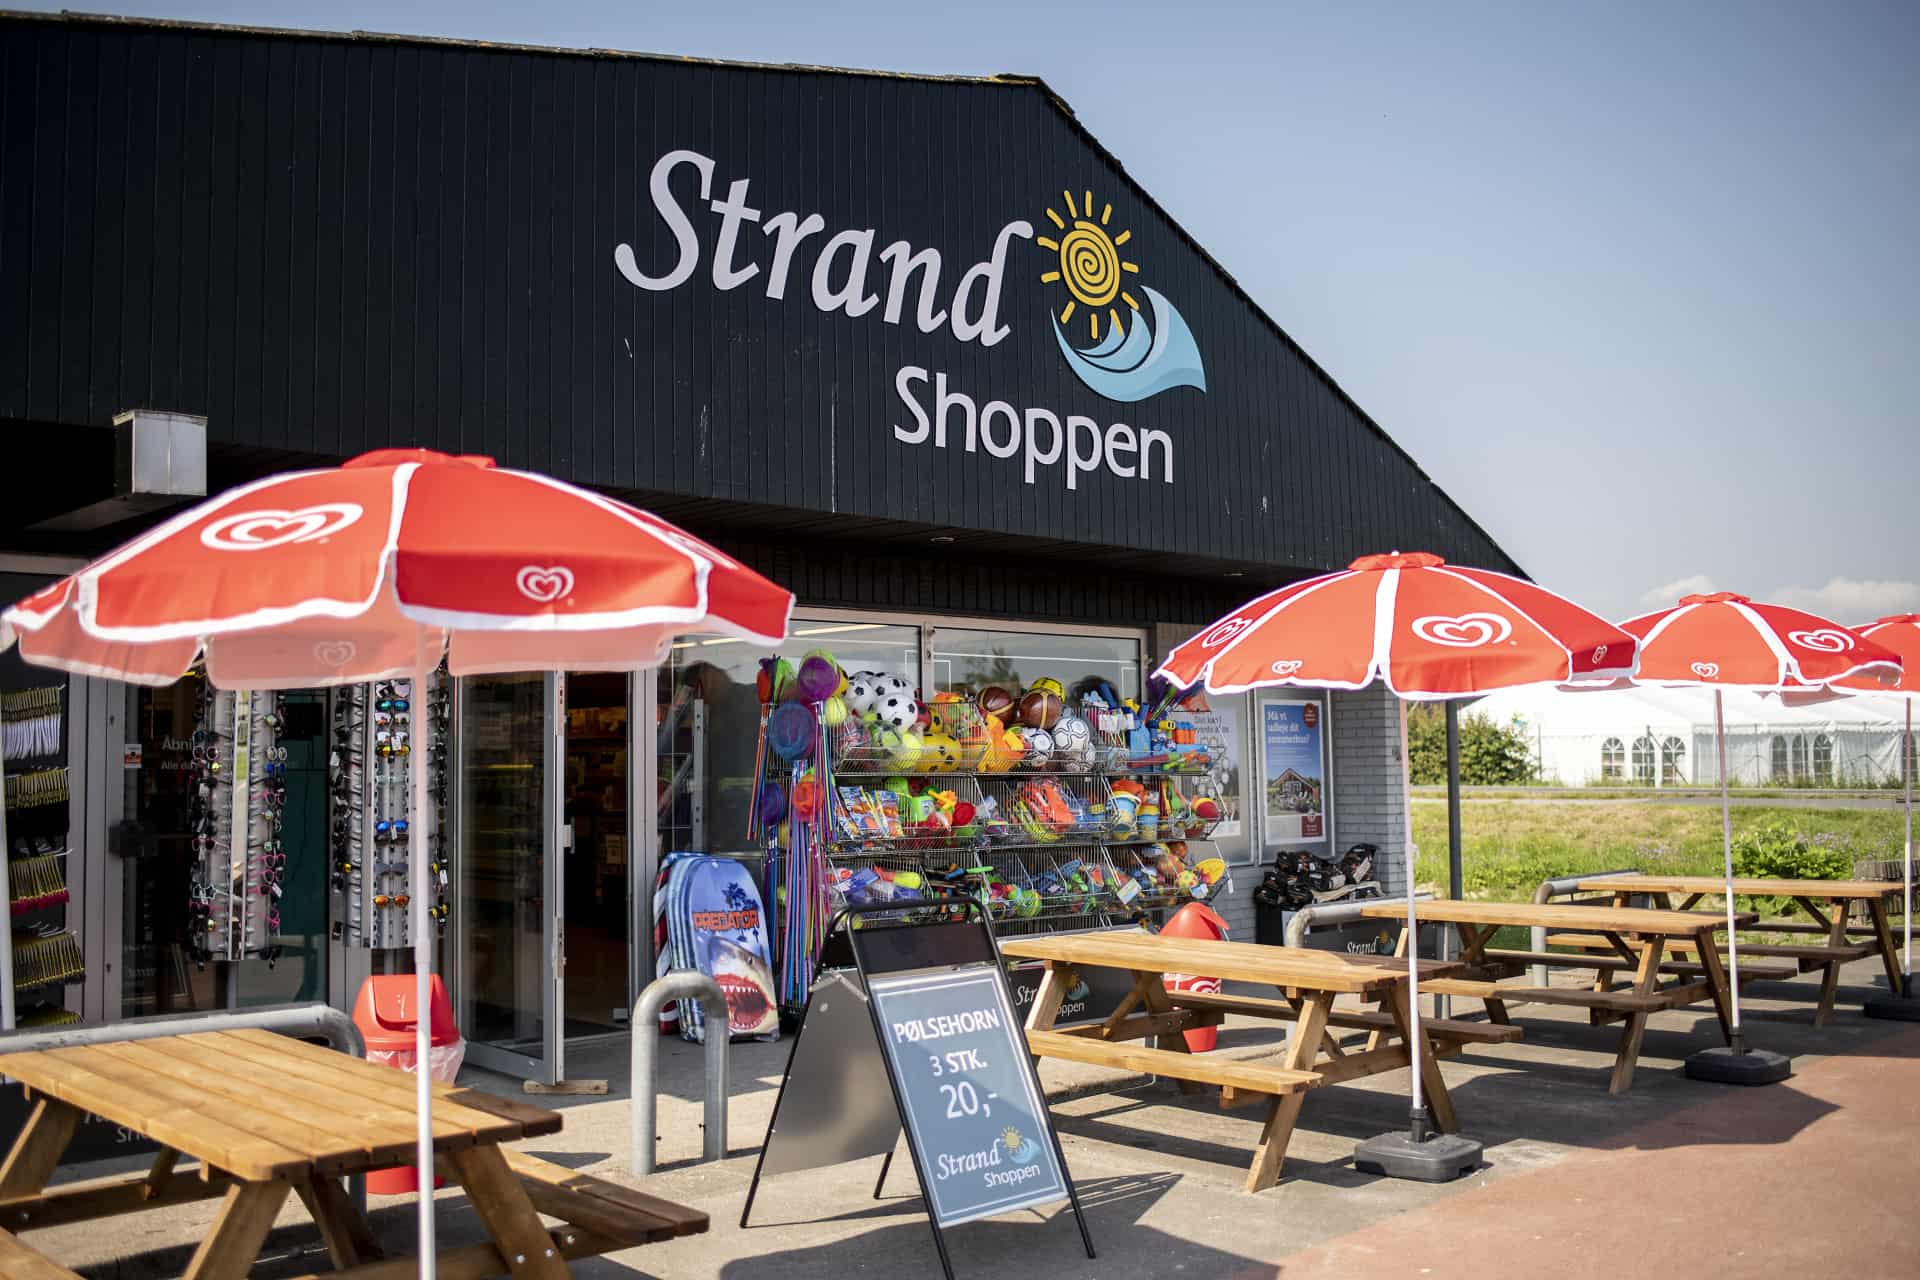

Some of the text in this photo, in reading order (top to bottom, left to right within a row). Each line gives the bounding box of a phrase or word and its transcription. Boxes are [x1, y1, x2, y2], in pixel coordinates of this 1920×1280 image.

[614, 149, 1034, 348] Strand
[893, 364, 1174, 490] Shoppen
[692, 909, 760, 931] PREDATOR
[1015, 985, 1038, 1006] Str
[1057, 1001, 1085, 1017] oppen
[893, 1008, 1001, 1044] PØLSEHORN
[928, 1048, 988, 1077] 3 STK.
[938, 1080, 998, 1120] 20,-
[936, 1137, 1002, 1181] Strand
[983, 1163, 1041, 1189] Shoppen
